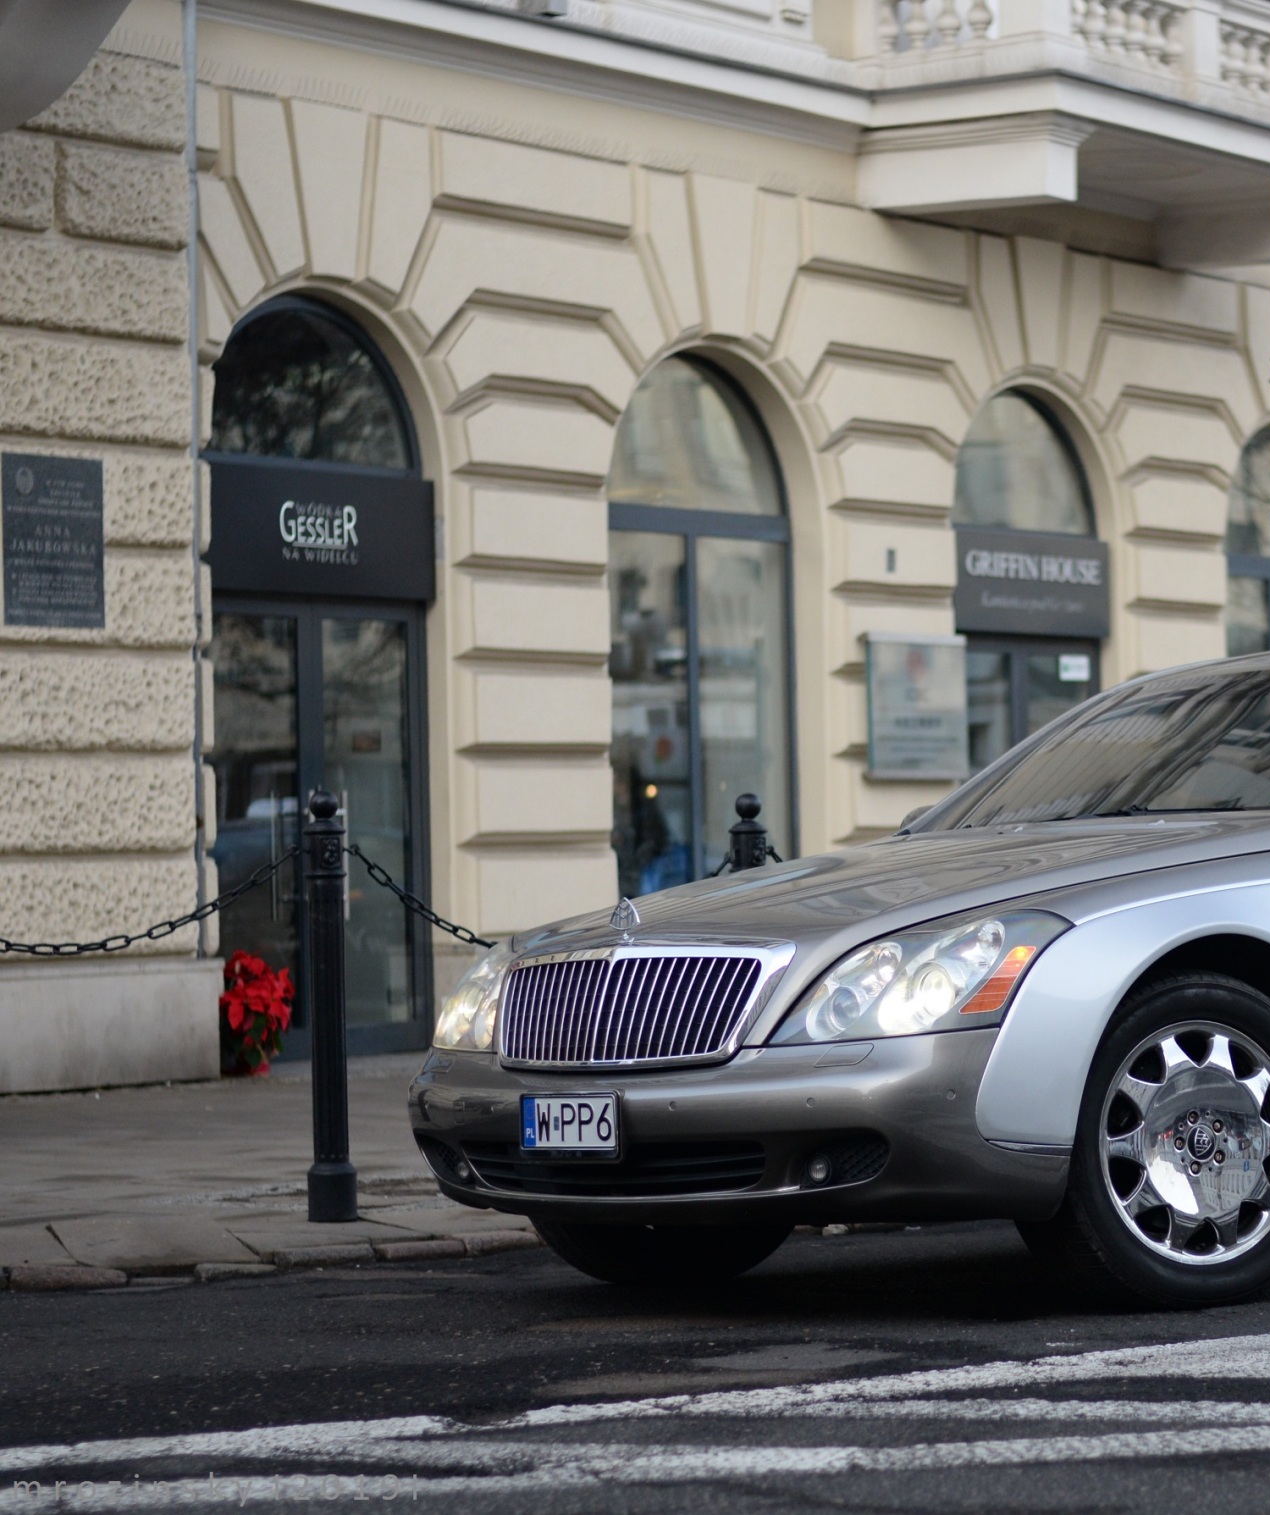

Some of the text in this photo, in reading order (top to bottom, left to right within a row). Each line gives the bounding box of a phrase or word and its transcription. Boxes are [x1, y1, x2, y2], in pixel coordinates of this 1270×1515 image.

[279, 500, 359, 547] GESSLER
[282, 546, 300, 561] NA
[965, 550, 1101, 585] GRIFFIN HOUSE
[526, 1128, 535, 1138] PL
